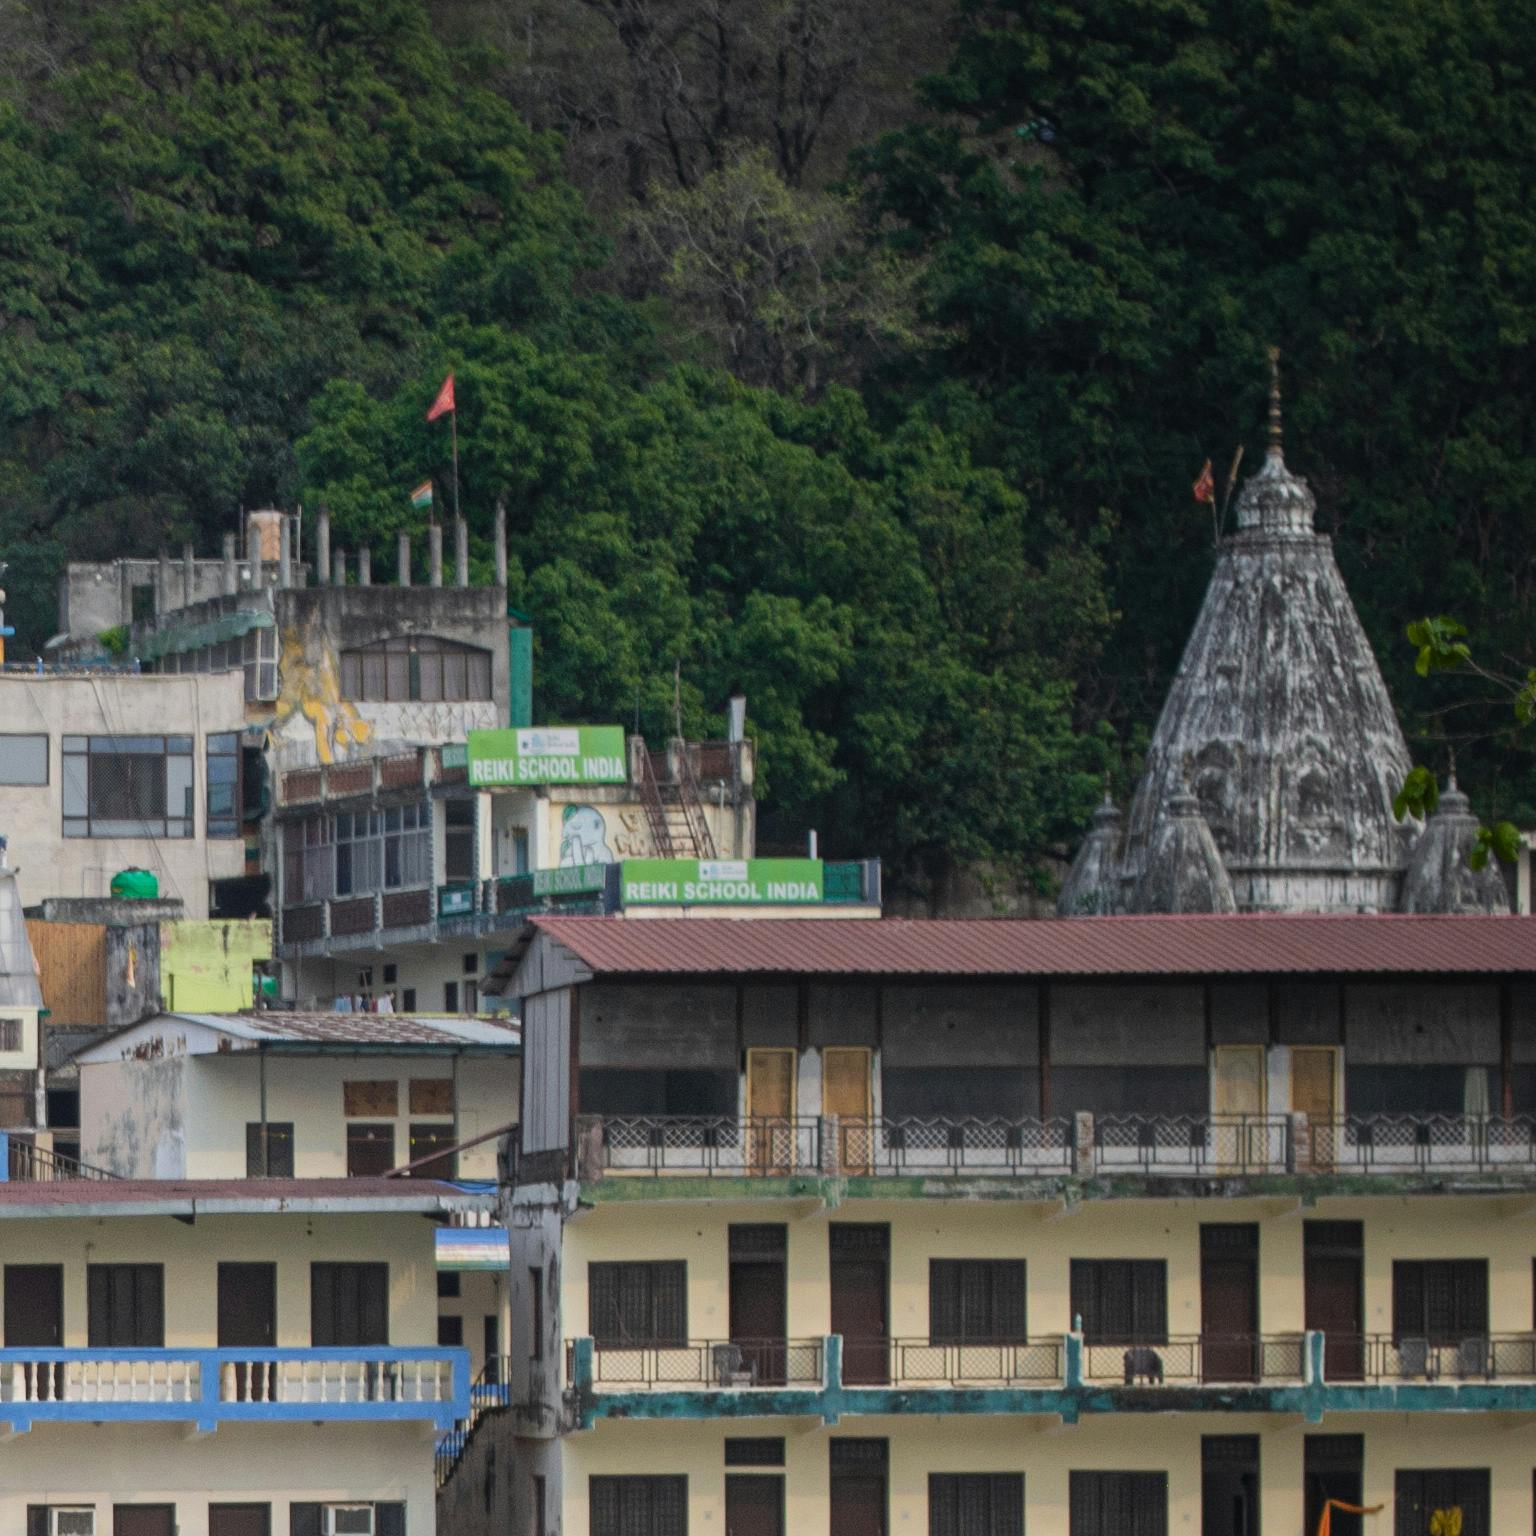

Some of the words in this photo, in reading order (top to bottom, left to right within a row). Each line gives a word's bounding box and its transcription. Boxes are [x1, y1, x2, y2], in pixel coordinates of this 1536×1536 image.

[473, 758, 515, 781] REIKI
[519, 756, 580, 780] SCHOOL
[583, 756, 626, 779] INDIA
[628, 883, 678, 900] REIKI
[684, 882, 762, 900] SCHOOL
[767, 882, 819, 900] INDIA
